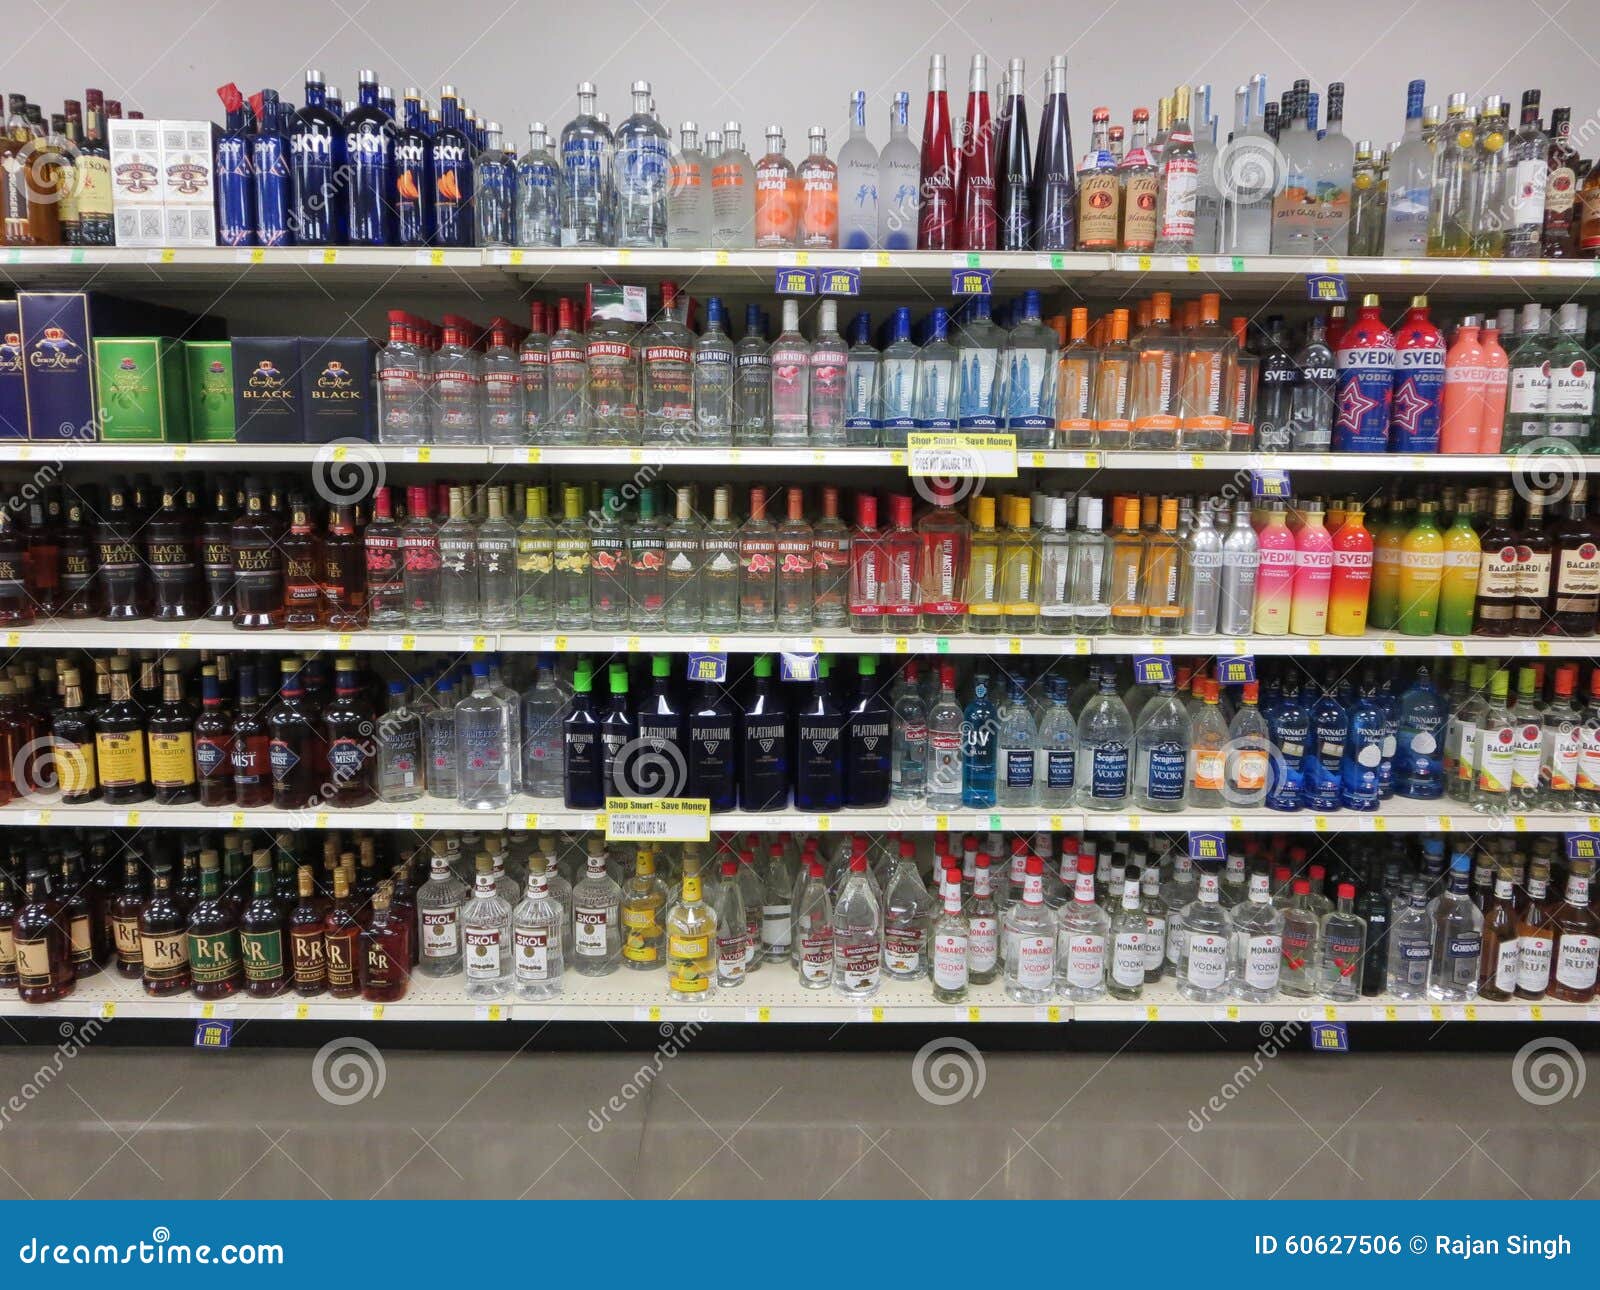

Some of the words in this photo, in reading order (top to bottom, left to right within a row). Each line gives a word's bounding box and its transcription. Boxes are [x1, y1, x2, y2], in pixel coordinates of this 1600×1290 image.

[291, 133, 332, 153] SKYY
[347, 133, 387, 153] SKYY
[395, 146, 425, 160] SKYY
[433, 146, 466, 160] SKYY
[588, 344, 627, 356] SMIRNOFF
[649, 351, 689, 361] SMIRNOFF
[696, 354, 731, 364] SMIRNOFF
[1348, 351, 1395, 366] SVEDK
[243, 391, 292, 399] BLACK
[312, 391, 360, 399] BLACK
[974, 418, 996, 426] VODKA
[1024, 418, 1046, 427] VODKA
[966, 437, 985, 445] Save
[987, 437, 1013, 448] Money
[699, 662, 717, 670] NEW
[1146, 663, 1162, 671] NEW
[1228, 664, 1245, 672] NEW
[640, 726, 677, 739] PLATINUM
[692, 727, 731, 740] PLATINUM
[748, 725, 785, 739] PLATINUM
[801, 727, 839, 740] PLATINUM
[852, 724, 888, 737] PLATINUM
[968, 731, 989, 747] UV
[334, 755, 357, 764] MIST
[1096, 752, 1127, 763] Seagram's
[1152, 753, 1184, 764] Seagram's
[1097, 769, 1125, 779] VODKA
[1153, 770, 1182, 780] VODKA
[609, 801, 628, 810] Shop
[631, 801, 653, 809] Smart
[661, 801, 680, 809] Save
[682, 801, 707, 811] Money
[613, 822, 626, 834] DOES
[1200, 840, 1216, 848] NEW
[424, 915, 454, 924] SKOL
[577, 914, 602, 923] SKOL
[468, 936, 497, 945] SKOL
[516, 936, 545, 945] SKOL
[887, 944, 914, 952] VODKA
[807, 954, 832, 962] VODKA
[849, 961, 878, 970] VODKA
[1193, 961, 1222, 970] VODKA
[1251, 963, 1278, 971] VODKA
[1565, 960, 1594, 969] RUM
[1321, 1030, 1337, 1038] NEW
